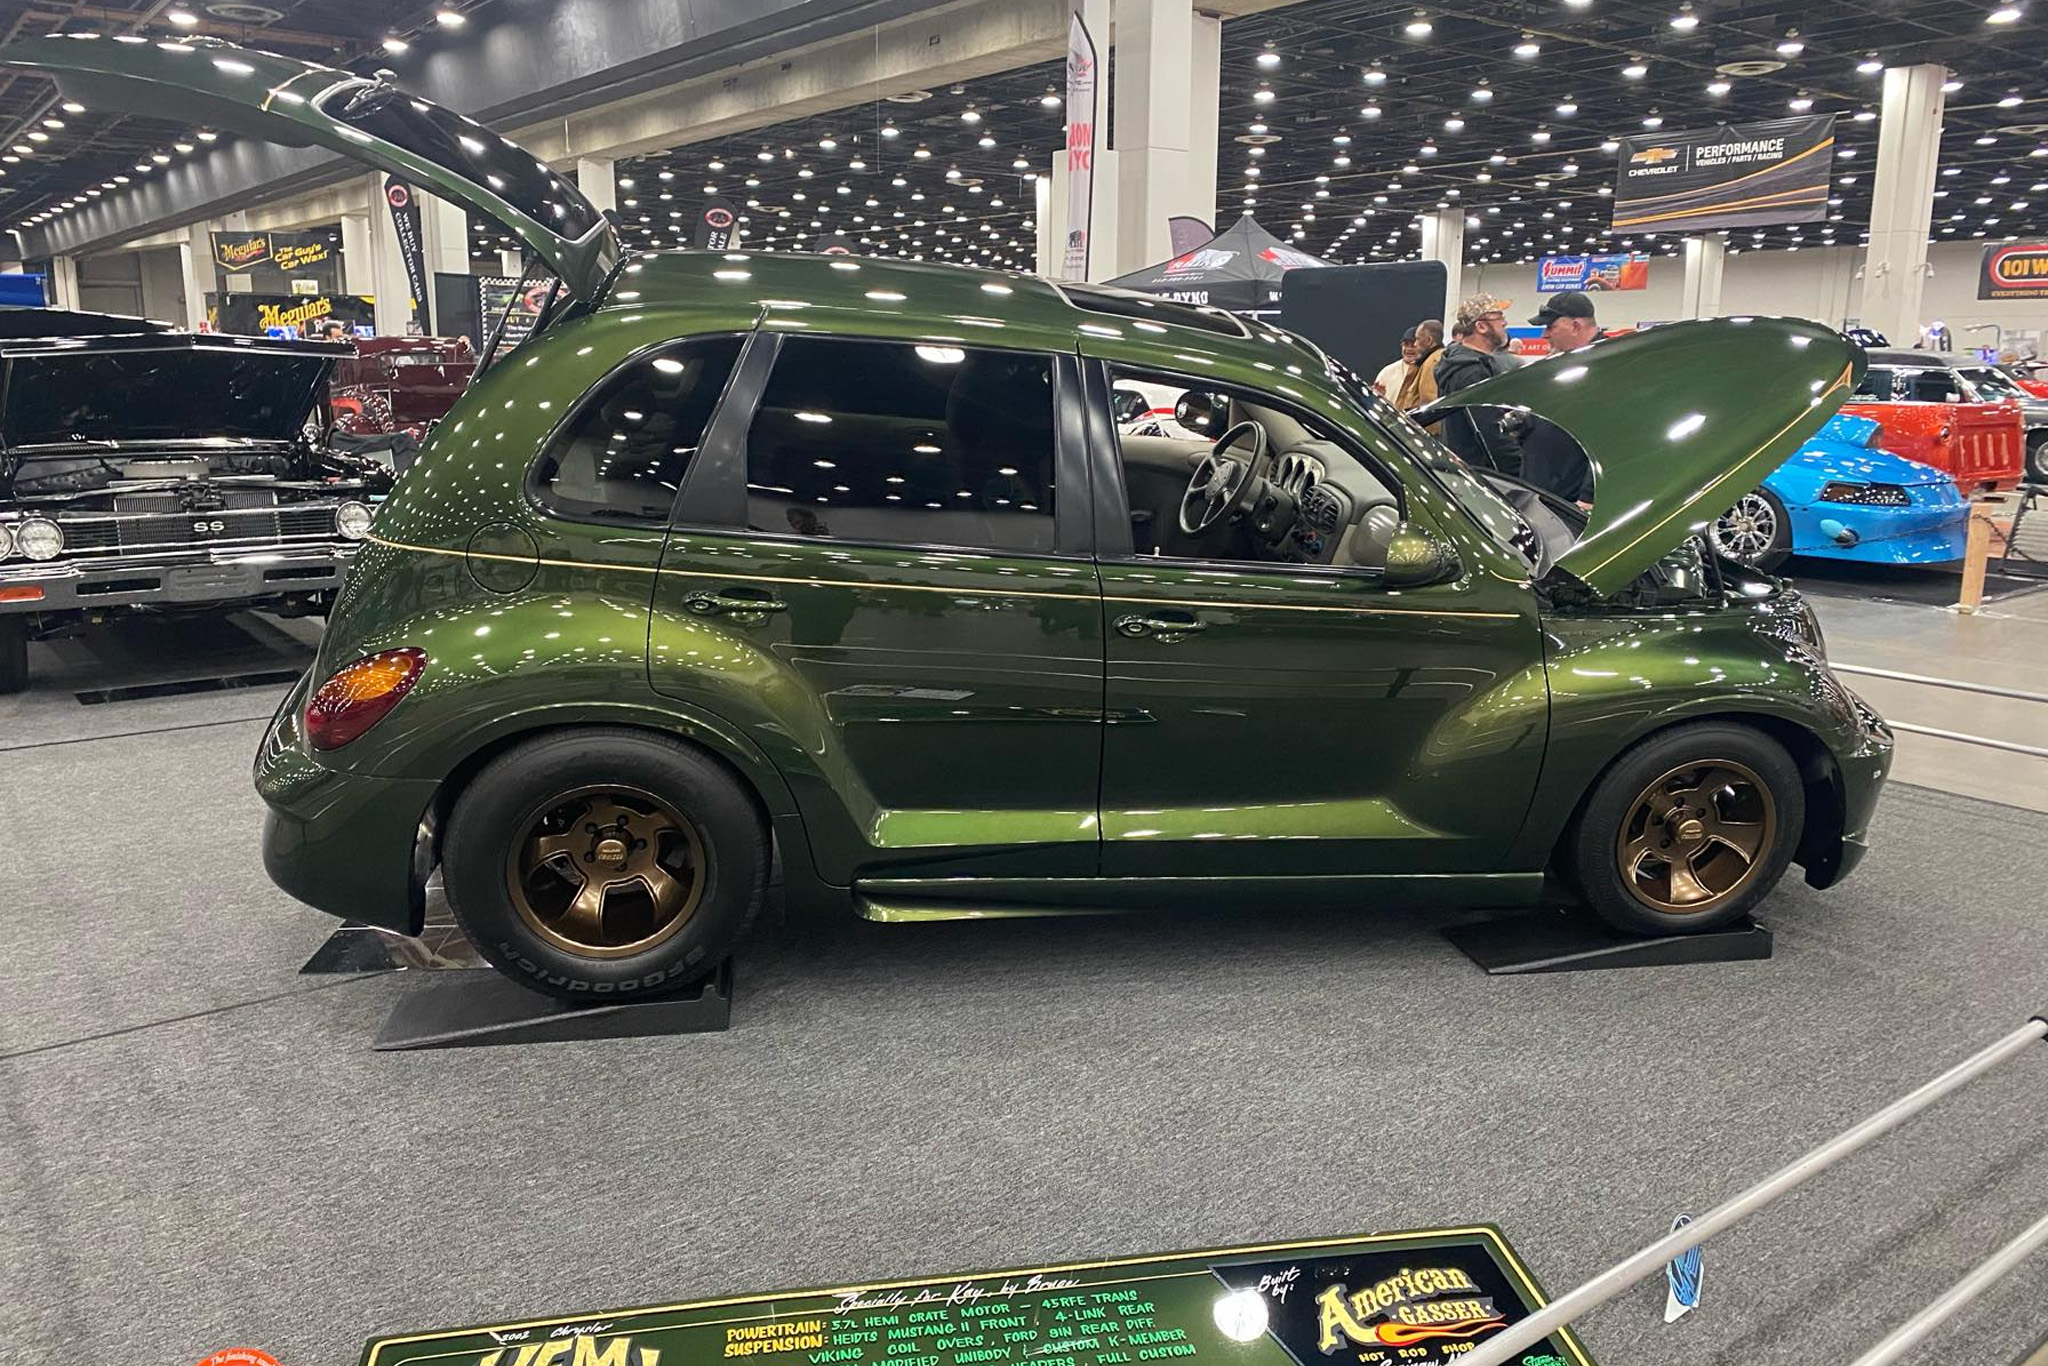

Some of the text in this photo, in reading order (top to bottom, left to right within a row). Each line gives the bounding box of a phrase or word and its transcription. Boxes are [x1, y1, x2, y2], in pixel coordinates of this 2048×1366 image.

[1696, 138, 1785, 159] PERFORMANCE
[1696, 158, 1726, 167] VEHICLES
[1732, 154, 1752, 163] PARTS
[1757, 152, 1783, 160] RACING
[1629, 165, 1679, 177] CHEVROLET
[403, 212, 417, 252] WE BUY
[274, 244, 322, 262] Car Guy's
[281, 250, 329, 270] Car Wax!
[395, 212, 422, 303] COLLECTOR CARS
[258, 297, 332, 333] Meguiar's
[193, 521, 225, 532] SS
[1257, 1266, 1301, 1292] Built
[832, 1290, 906, 1315] Specially
[911, 1290, 942, 1306] for
[1000, 1279, 1019, 1298] by
[1024, 1274, 1079, 1293] Bruce
[1272, 1283, 1294, 1304] by:
[726, 1290, 1138, 1341] POWERTRAIN: 5.7L HEMI CRATE MOTOR 45RFE TRANS
[1319, 1268, 1472, 1350] American
[1399, 1299, 1490, 1325] GASSER
[502, 1322, 614, 1342] 2002 Chrysler
[724, 1334, 829, 1357] SUSPENSION:
[833, 1331, 878, 1345] HEIDTS
[888, 1323, 957, 1339] MUSTANG
[1055, 1307, 1106, 1322] 4-LINK
[1118, 1303, 1155, 1316] REAR
[809, 1347, 864, 1364] VIKING
[887, 1342, 921, 1355] COIL
[1004, 1331, 1038, 1343] FORD
[1081, 1322, 1119, 1335] REAR
[955, 1347, 1011, 1364] UNIBODY
[1043, 1339, 1099, 1355] CUSTOM
[1108, 1328, 1187, 1347] K-MEMBER
[1097, 1352, 1131, 1364] FULL
[1139, 1344, 1196, 1360] CUSTOM
[1359, 1342, 1475, 1362] HOT ROD SHOP
